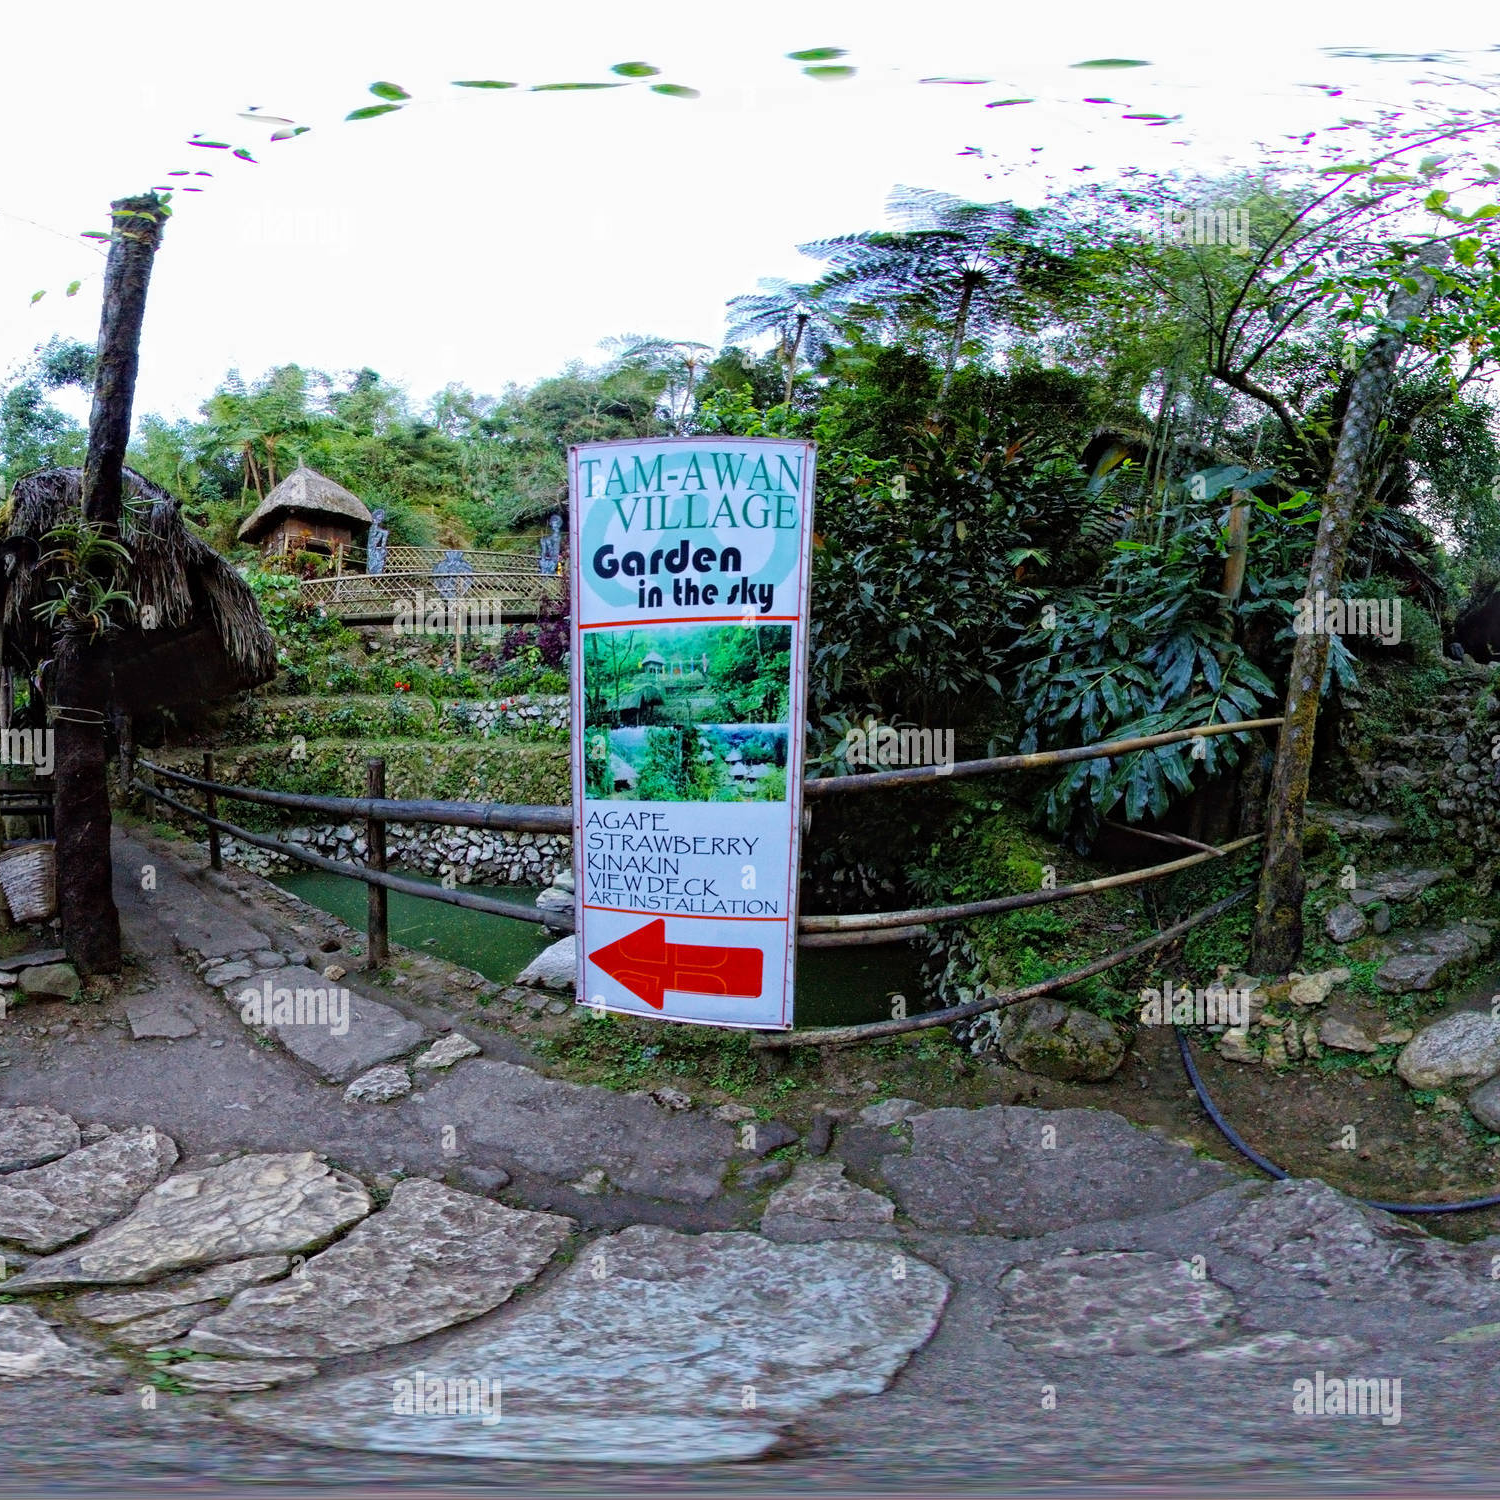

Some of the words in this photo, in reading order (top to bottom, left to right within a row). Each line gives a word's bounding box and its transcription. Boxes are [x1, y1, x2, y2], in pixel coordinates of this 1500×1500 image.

[579, 452, 803, 498] TAM-AWAN
[612, 493, 798, 533] VILLAGE
[593, 540, 742, 579] Garden
[638, 579, 663, 608] in
[673, 578, 719, 607] the
[727, 577, 774, 613] sky
[585, 811, 669, 831] AGAPE
[587, 832, 759, 856] STRAWBERRY
[587, 853, 679, 875] KINAKIN
[588, 873, 642, 891] VIEW
[648, 876, 719, 897] DECK
[588, 891, 626, 905] ART
[630, 893, 778, 914] INSTALLATION
